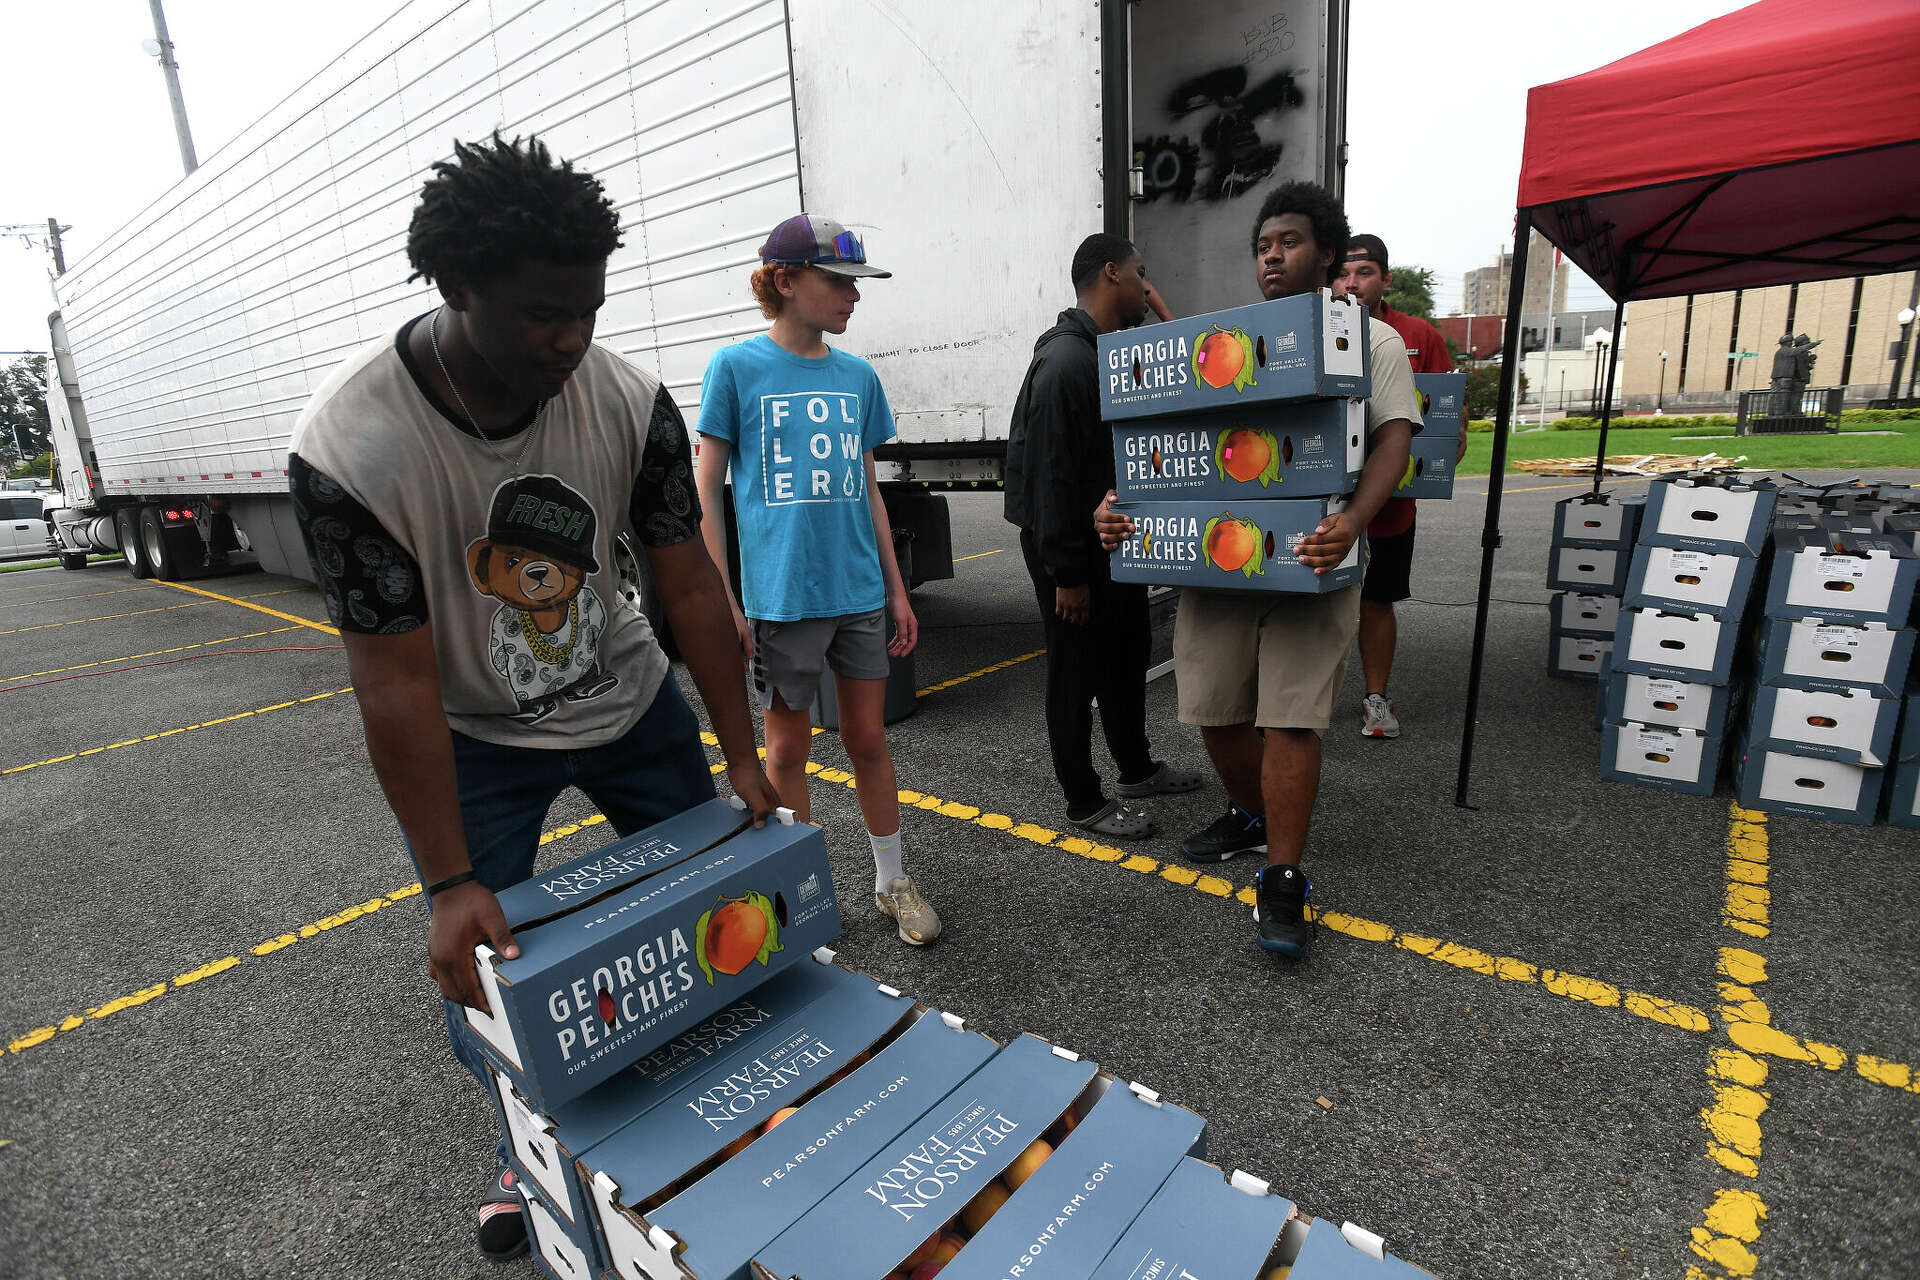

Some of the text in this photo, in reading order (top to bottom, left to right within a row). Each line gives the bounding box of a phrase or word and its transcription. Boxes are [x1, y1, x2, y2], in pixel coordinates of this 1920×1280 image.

[865, 350, 900, 361] STRAIGHT
[908, 347, 920, 355] TO
[922, 343, 949, 353] CLOSE
[1108, 336, 1188, 370] GEORGIA
[1125, 430, 1211, 457] GEORGIA
[506, 494, 591, 541] FRESH
[1133, 516, 1199, 537] EORGIA
[539, 855, 622, 894] FARM
[552, 843, 682, 901] PEARSON
[584, 855, 735, 930] PEARSONFARM.COM
[548, 927, 689, 1023] GEORGIA
[567, 998, 689, 1075] OUR SWEETEST AND FINEST
[632, 1001, 757, 1076] PEARSON
[697, 1007, 774, 1057] FARM
[770, 1033, 810, 1061] SINCE 1885
[653, 1067, 677, 1082] SINCE
[686, 1057, 773, 1118] FARM
[704, 1040, 836, 1132] PEARSON
[761, 1075, 909, 1188] PEARSONFARM.COM
[947, 1105, 986, 1138] SINCE 1885
[864, 1134, 953, 1206] FARM
[889, 1113, 1019, 1223] PEARSON
[1001, 1161, 1114, 1280] RSONFARM.COM
[1142, 1257, 1166, 1280] SINCE
